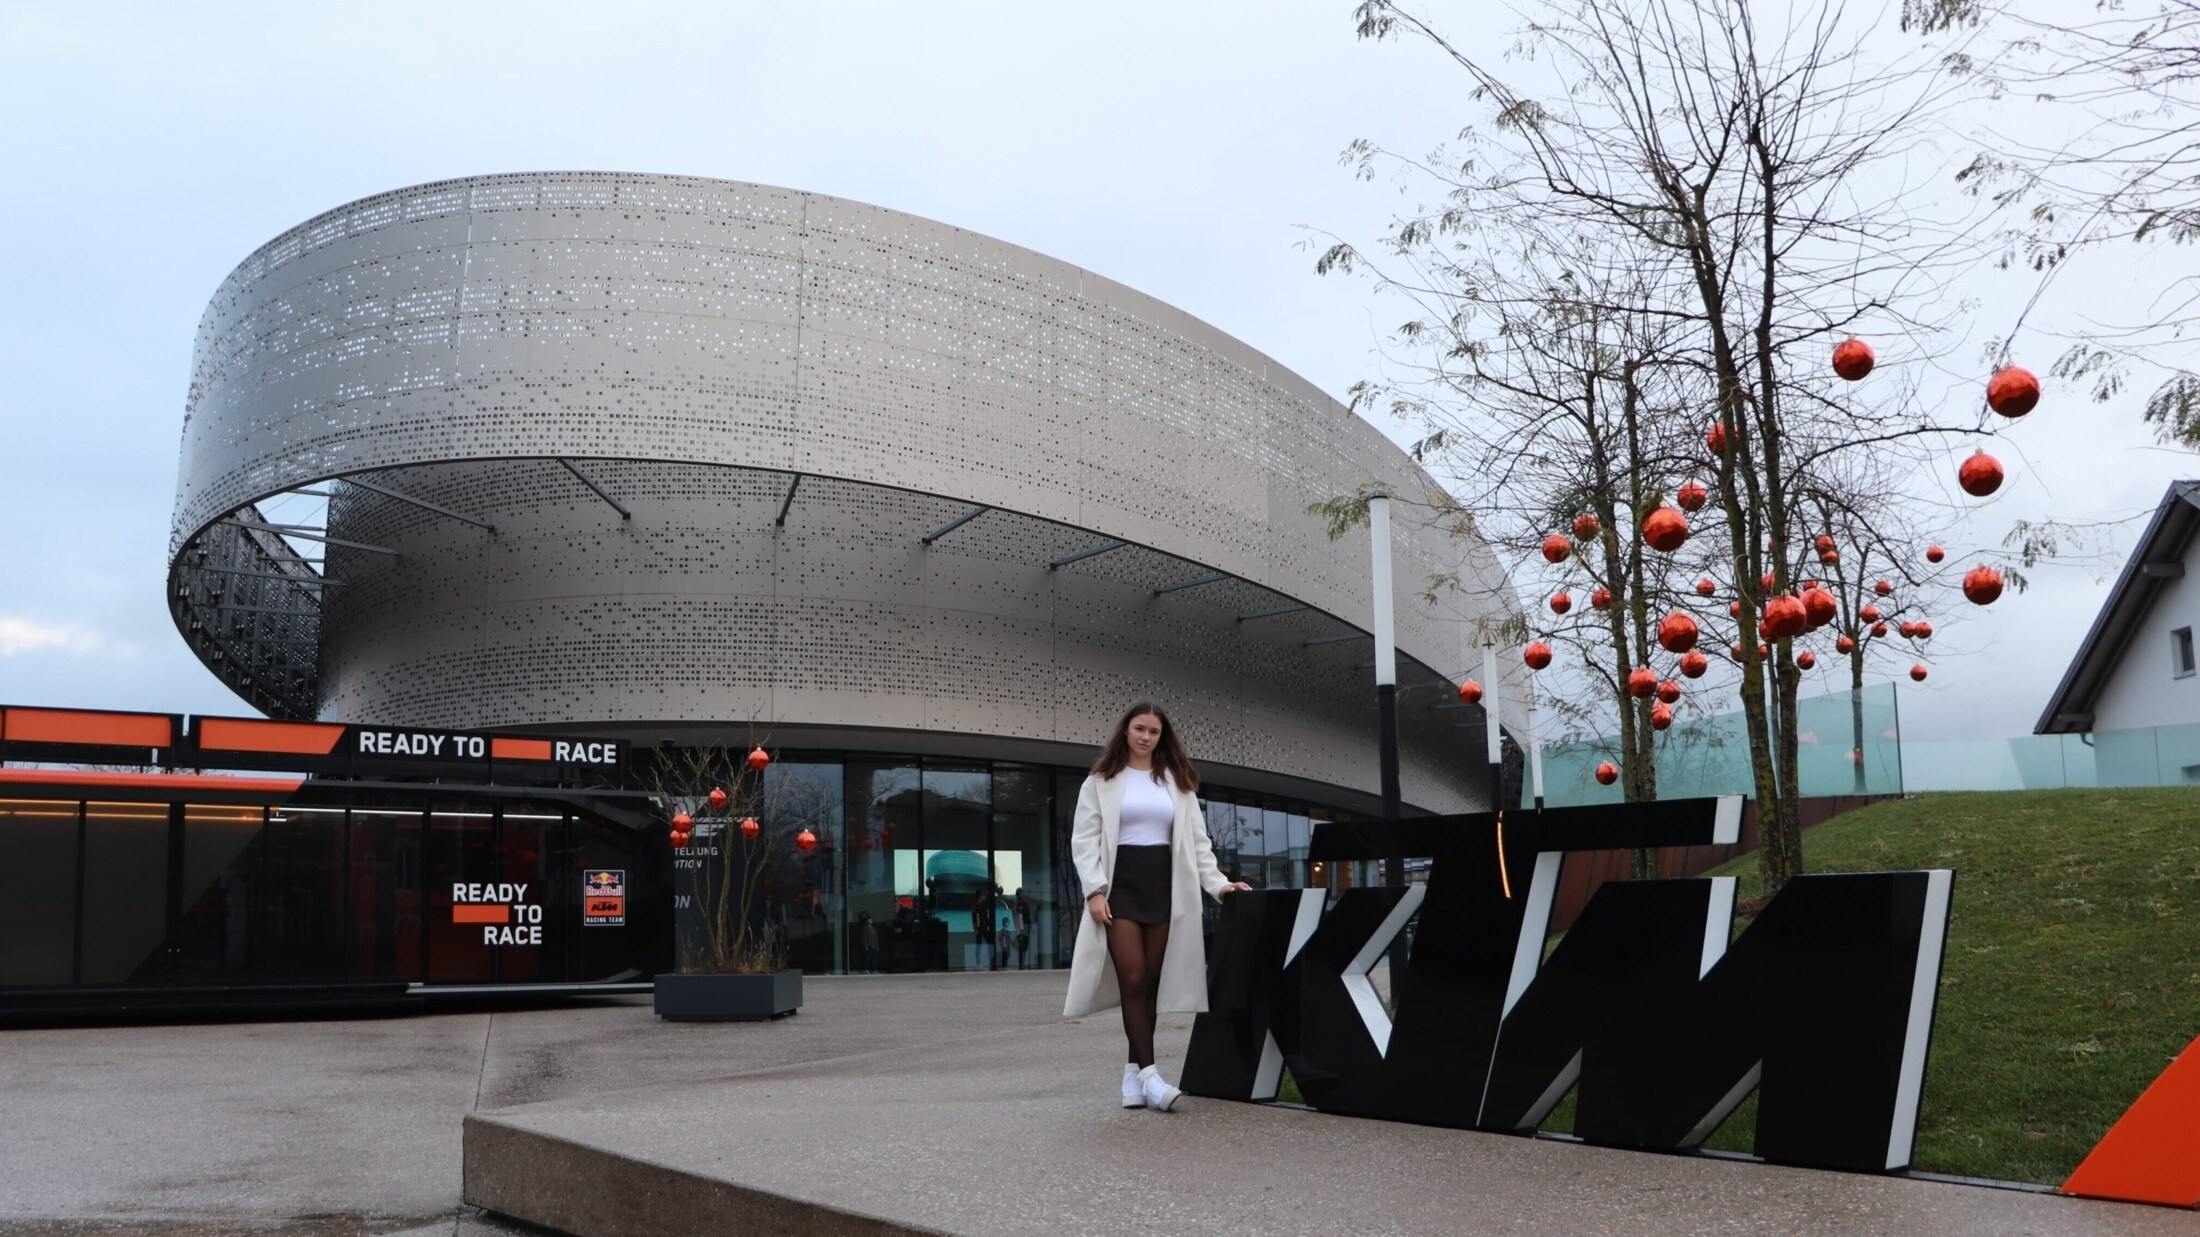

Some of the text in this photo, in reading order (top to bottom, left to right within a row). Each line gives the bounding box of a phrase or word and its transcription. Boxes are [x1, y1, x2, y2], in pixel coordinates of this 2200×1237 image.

[360, 731, 617, 764] READY TO RACE
[674, 859, 702, 869] ITION
[453, 883, 528, 902] READY
[586, 885, 623, 896] Red Bull
[514, 904, 542, 924] TO
[591, 901, 618, 912] KTM
[484, 926, 542, 945] RACE
[1180, 795, 1957, 1173] KTM
